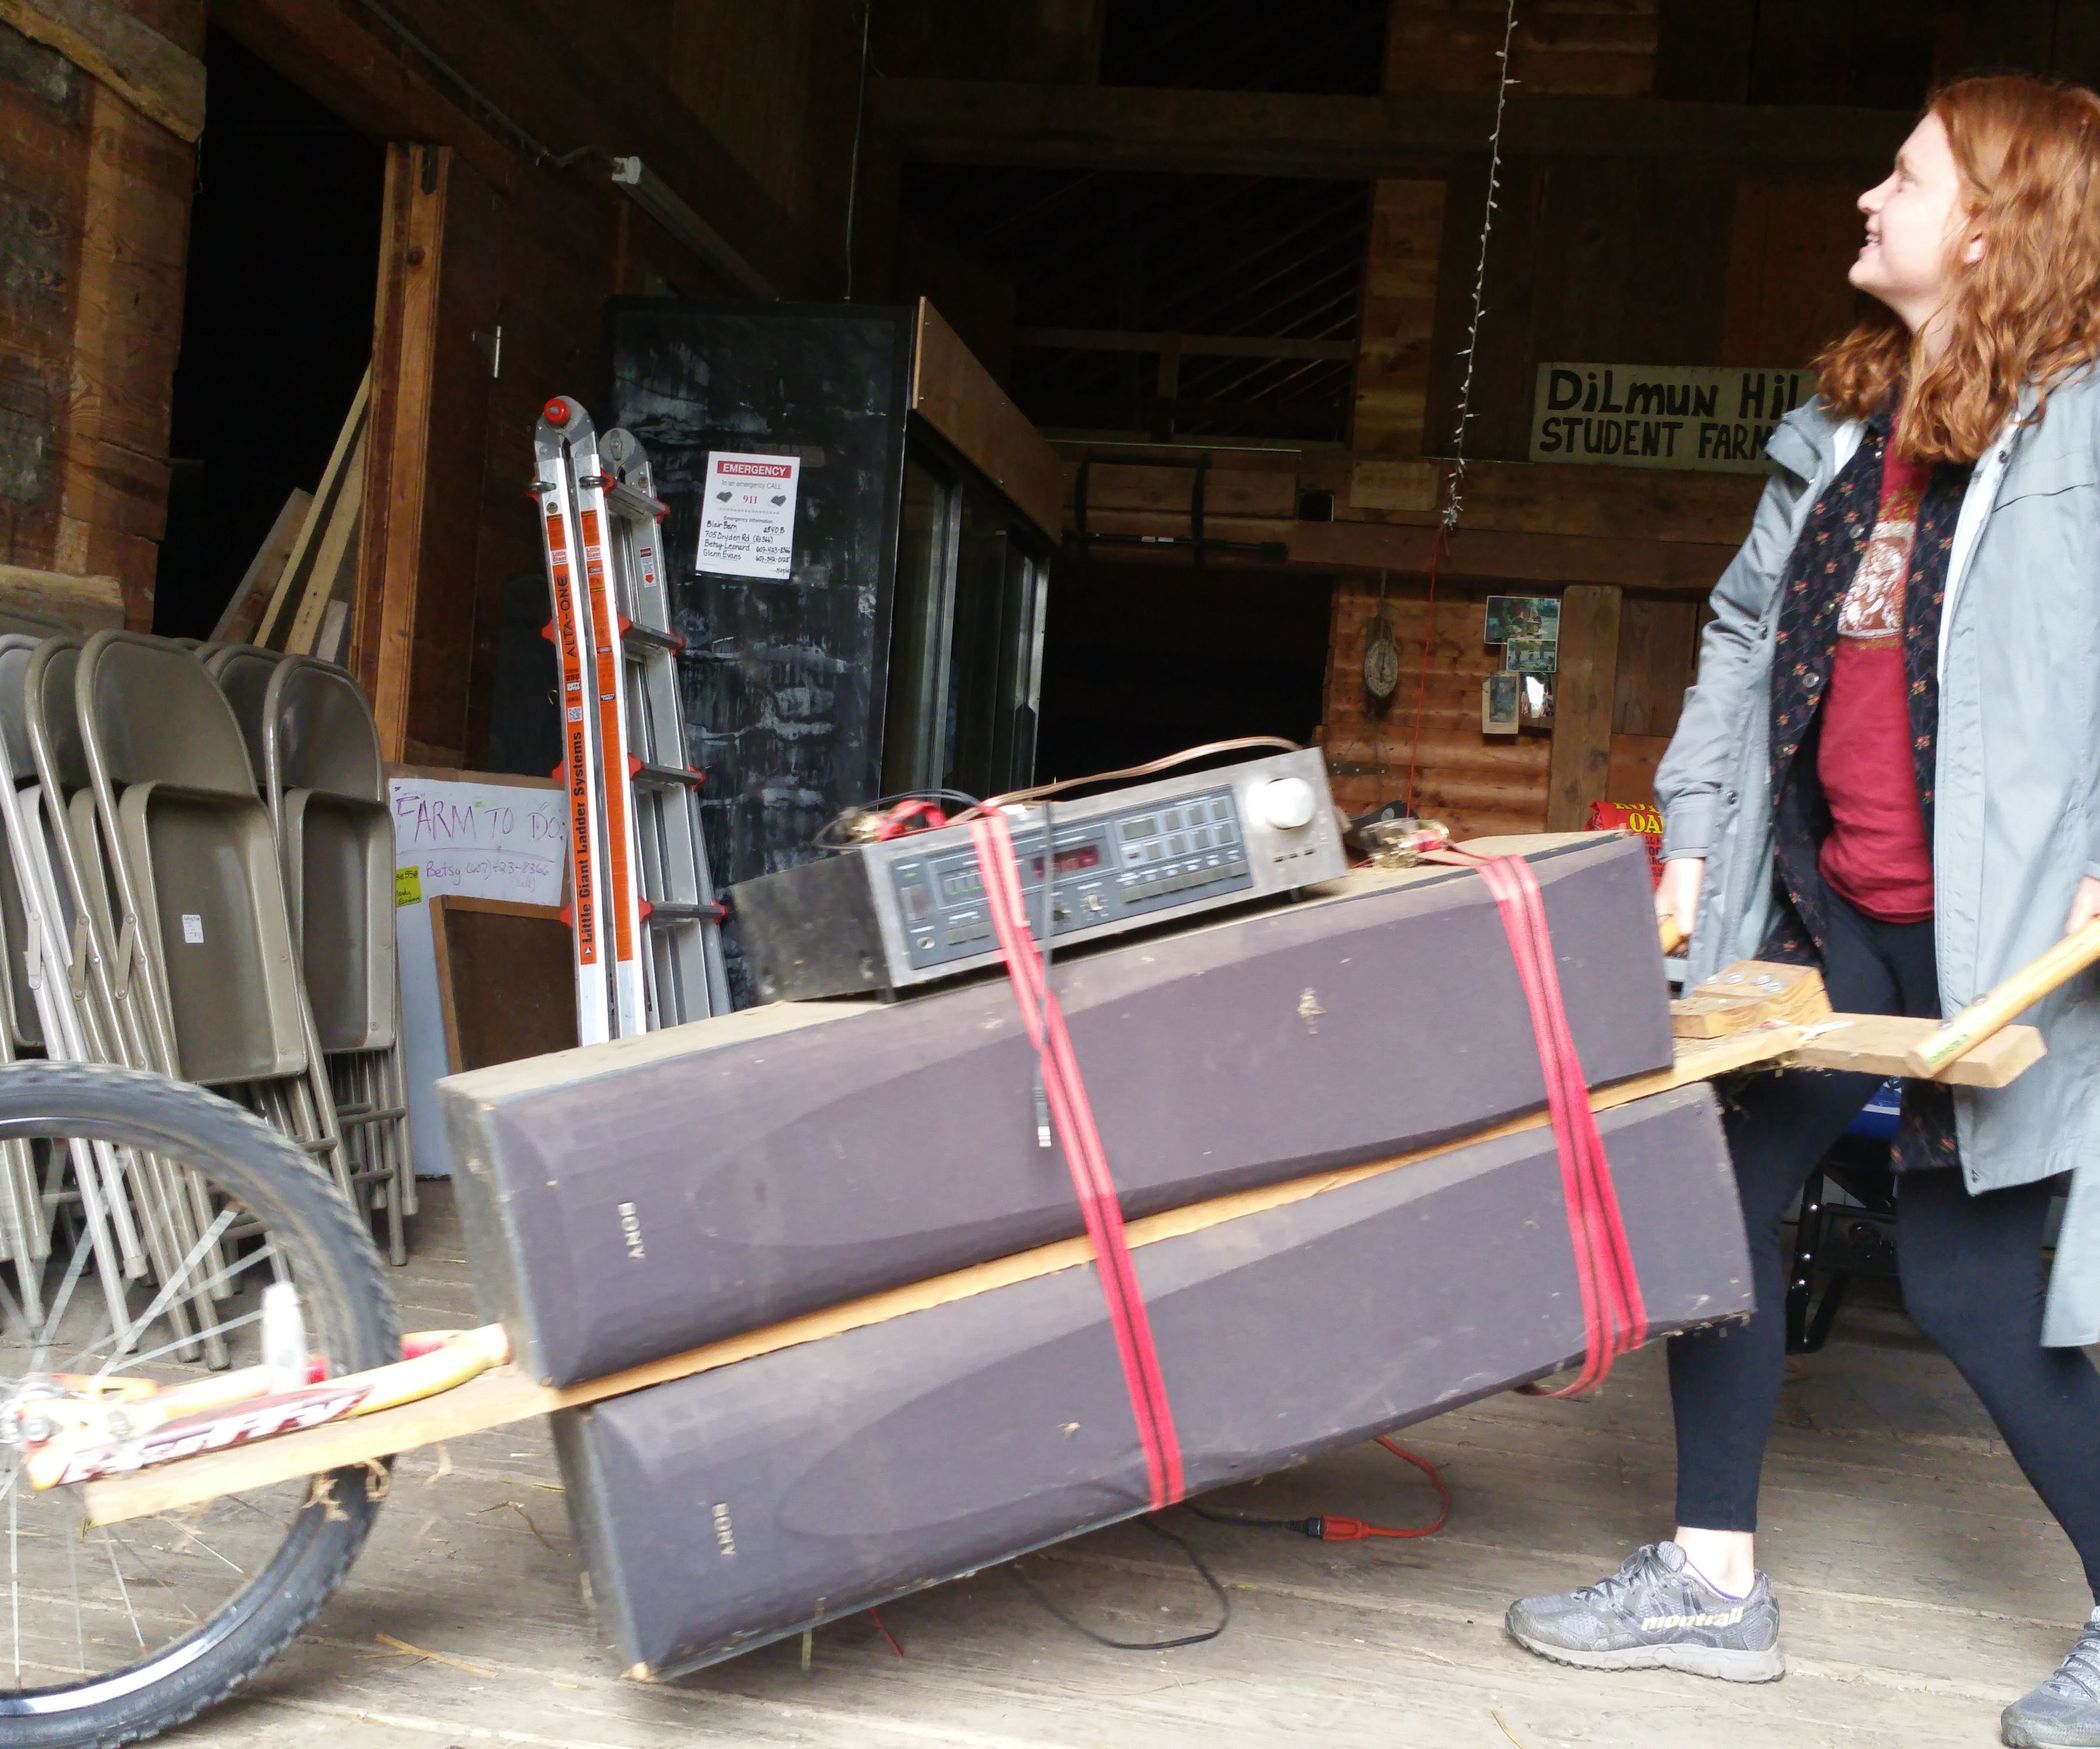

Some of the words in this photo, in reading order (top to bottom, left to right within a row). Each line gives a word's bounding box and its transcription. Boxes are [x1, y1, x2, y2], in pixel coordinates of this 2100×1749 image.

[1540, 417, 1684, 457] STUDENT
[722, 463, 786, 477] EMERGENCY
[736, 481, 766, 489] emergency
[766, 482, 782, 490] CALL
[743, 495, 758, 504] 911
[723, 515, 748, 523] Emergency
[705, 530, 716, 539] 705
[717, 532, 740, 542] Dryden
[722, 550, 741, 560] Evans
[557, 575, 576, 657] ALTA-ONE
[573, 732, 585, 797] Systems
[396, 795, 477, 842] FARM
[485, 807, 514, 840] TO
[576, 803, 587, 854] Ladder
[426, 861, 461, 886] Betsy
[578, 860, 590, 898] Giant
[581, 904, 592, 943] Little
